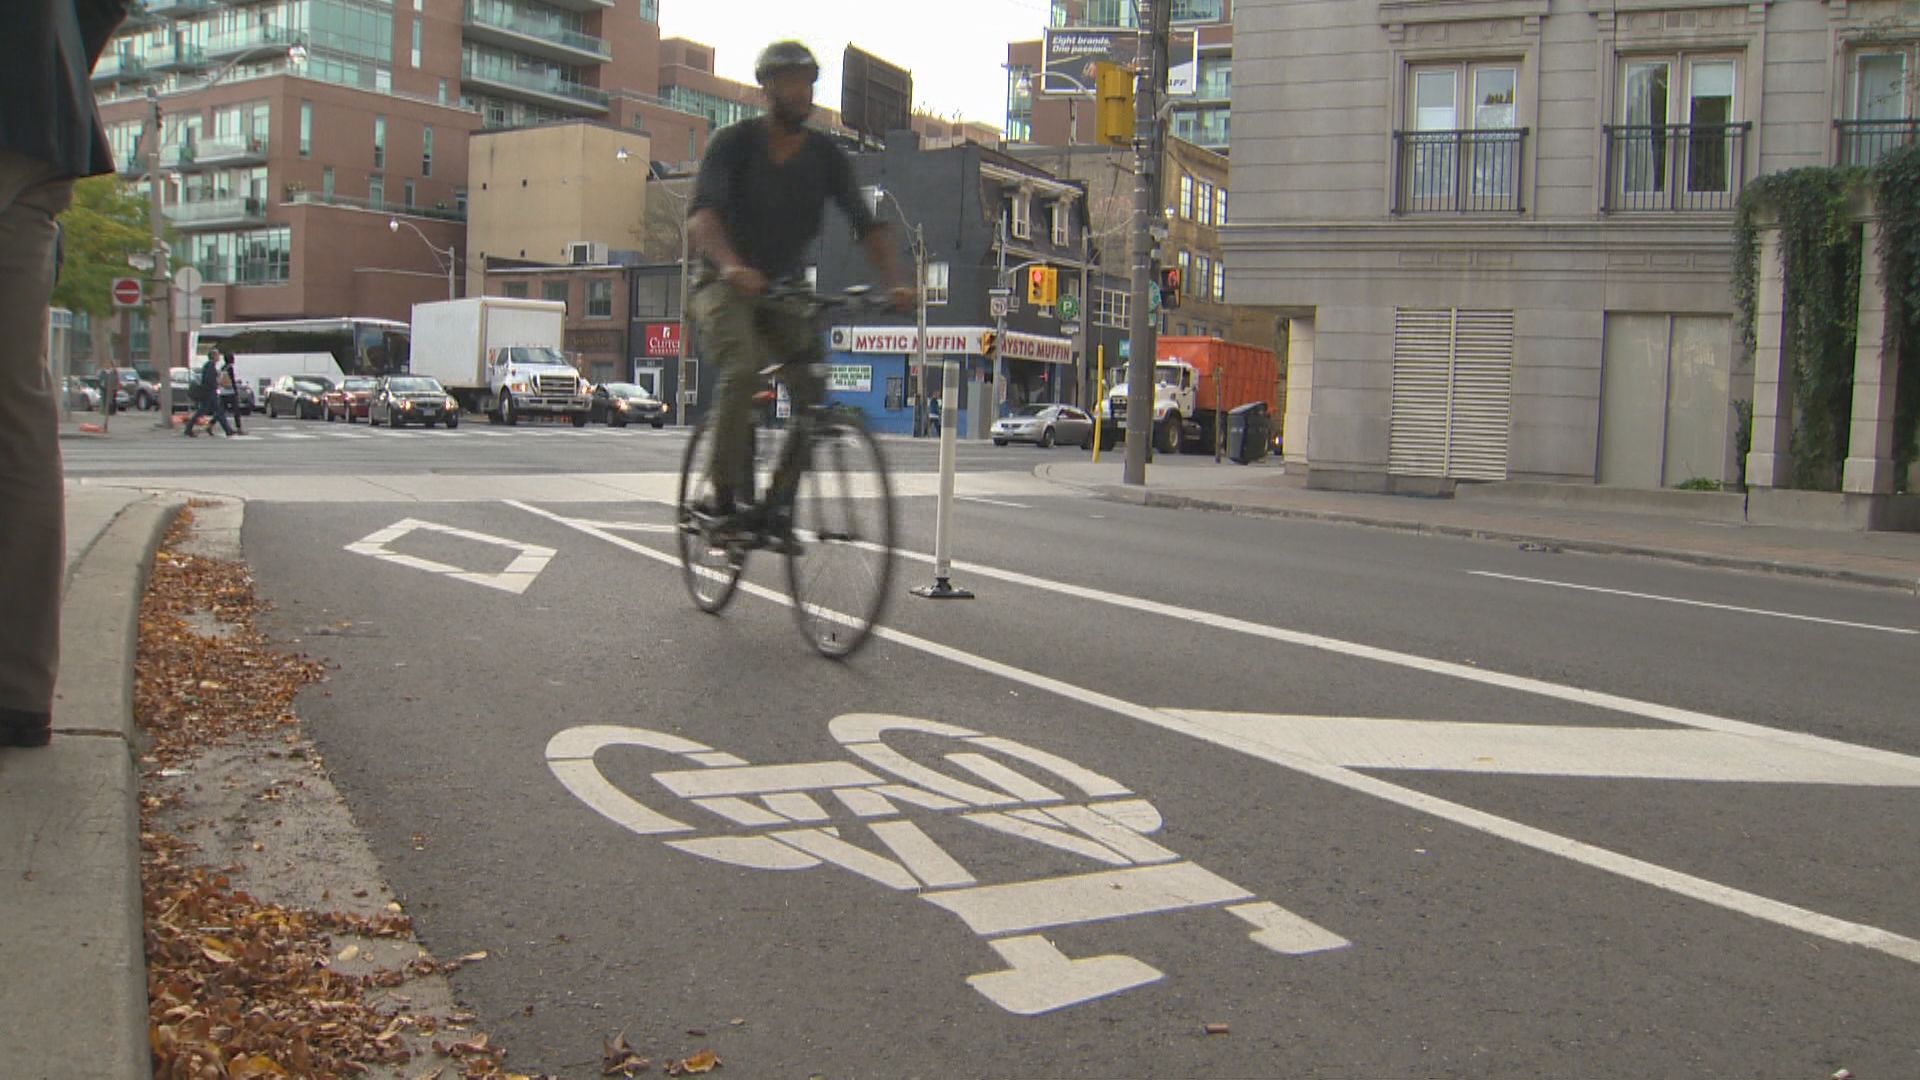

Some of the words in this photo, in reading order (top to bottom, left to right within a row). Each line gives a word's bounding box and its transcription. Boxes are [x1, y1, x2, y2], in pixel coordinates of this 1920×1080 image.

[1052, 36, 1075, 46] Eight
[856, 335, 908, 350] MYSTIC
[1037, 341, 1070, 361] MUFFIN
